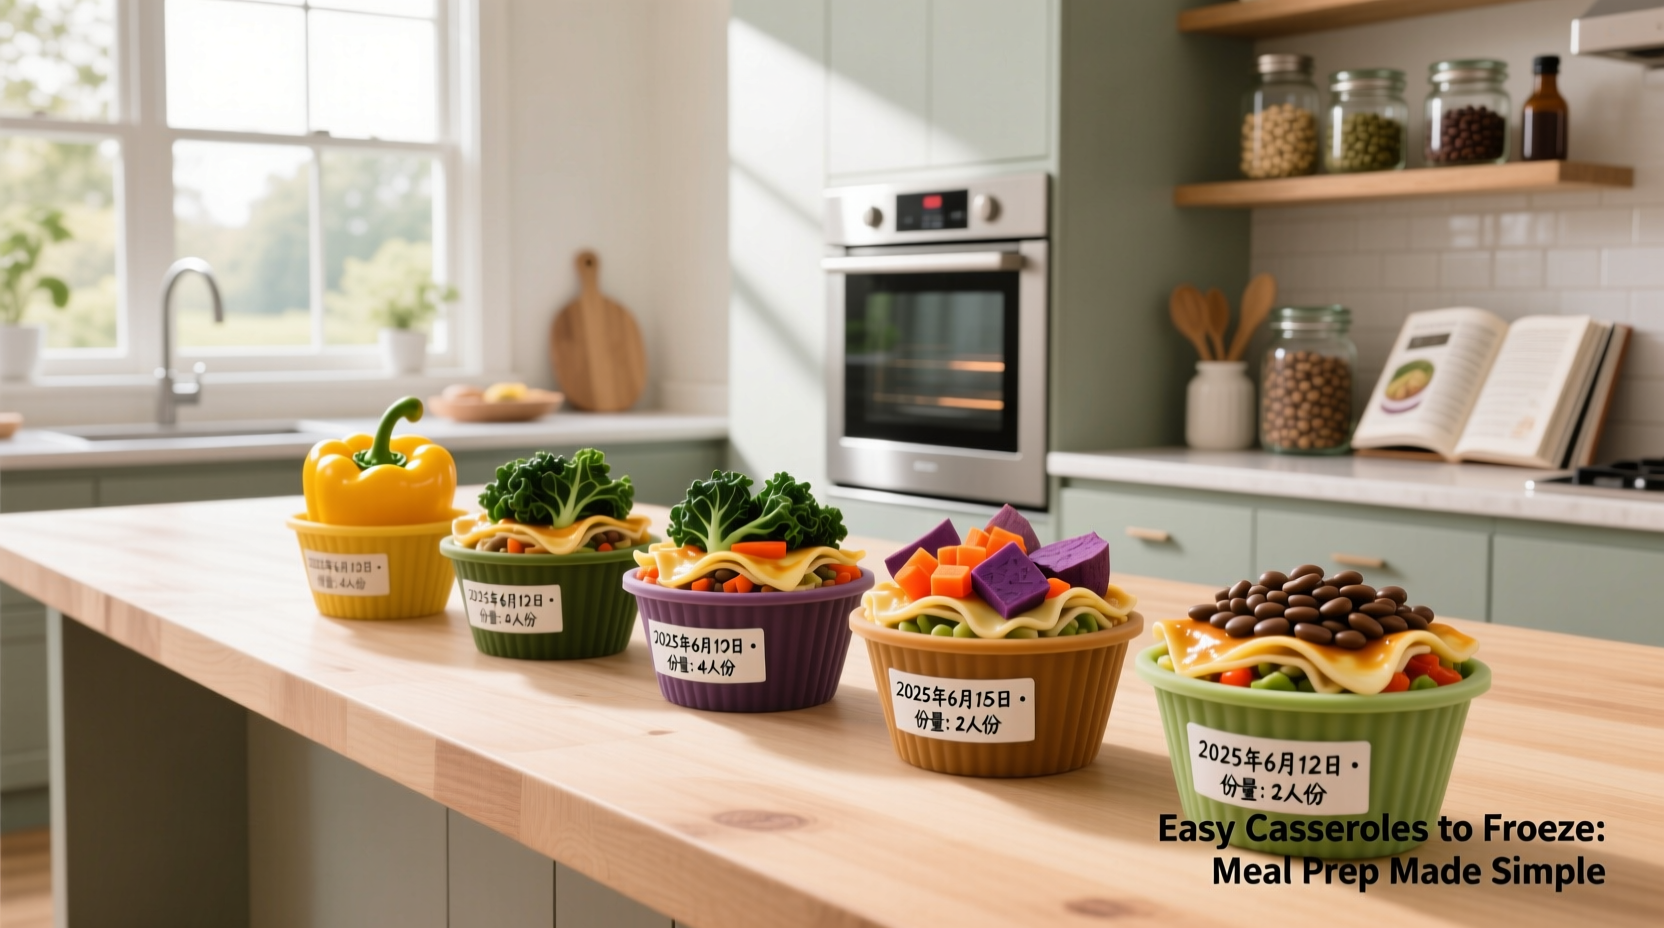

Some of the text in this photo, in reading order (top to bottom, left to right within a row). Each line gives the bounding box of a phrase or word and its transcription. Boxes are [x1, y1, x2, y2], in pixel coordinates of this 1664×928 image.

[896, 681, 1010, 709] 2025年6月15日
[1198, 740, 1340, 776] 2025年6月12日
